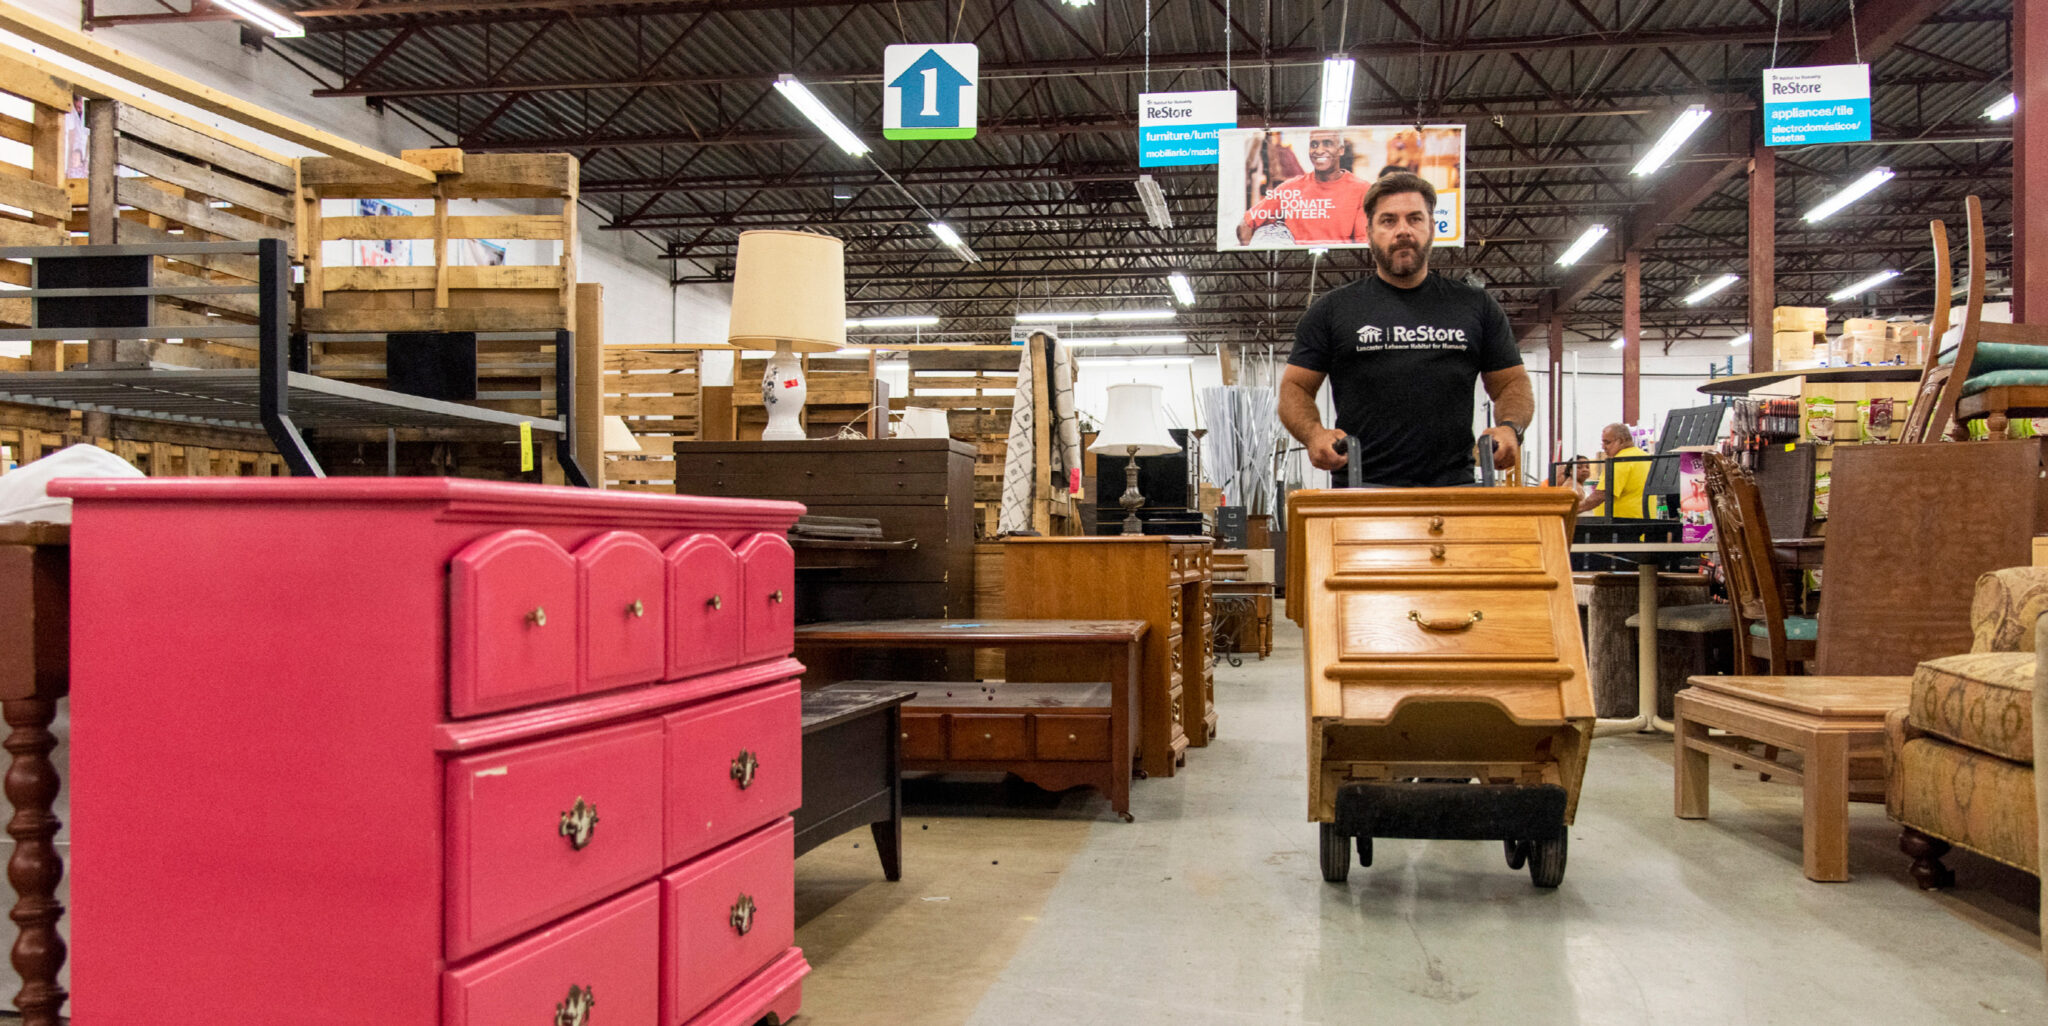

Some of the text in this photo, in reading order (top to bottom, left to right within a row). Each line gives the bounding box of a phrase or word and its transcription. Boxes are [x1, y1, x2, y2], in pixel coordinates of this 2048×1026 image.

[920, 67, 940, 116] 1
[1772, 82, 1821, 95] ReStore
[1147, 106, 1192, 119] ReStore
[1771, 105, 1854, 121] appliances/tile
[1772, 121, 1861, 134] electrodomésticos/
[1146, 129, 1219, 142] furniture/lumb
[1772, 133, 1806, 143] losetas
[1265, 189, 1302, 200] SHOP.
[1280, 198, 1336, 210] DONATE.
[1250, 208, 1330, 220] VOLUNTEER.
[1393, 325, 1466, 342] ReStore
